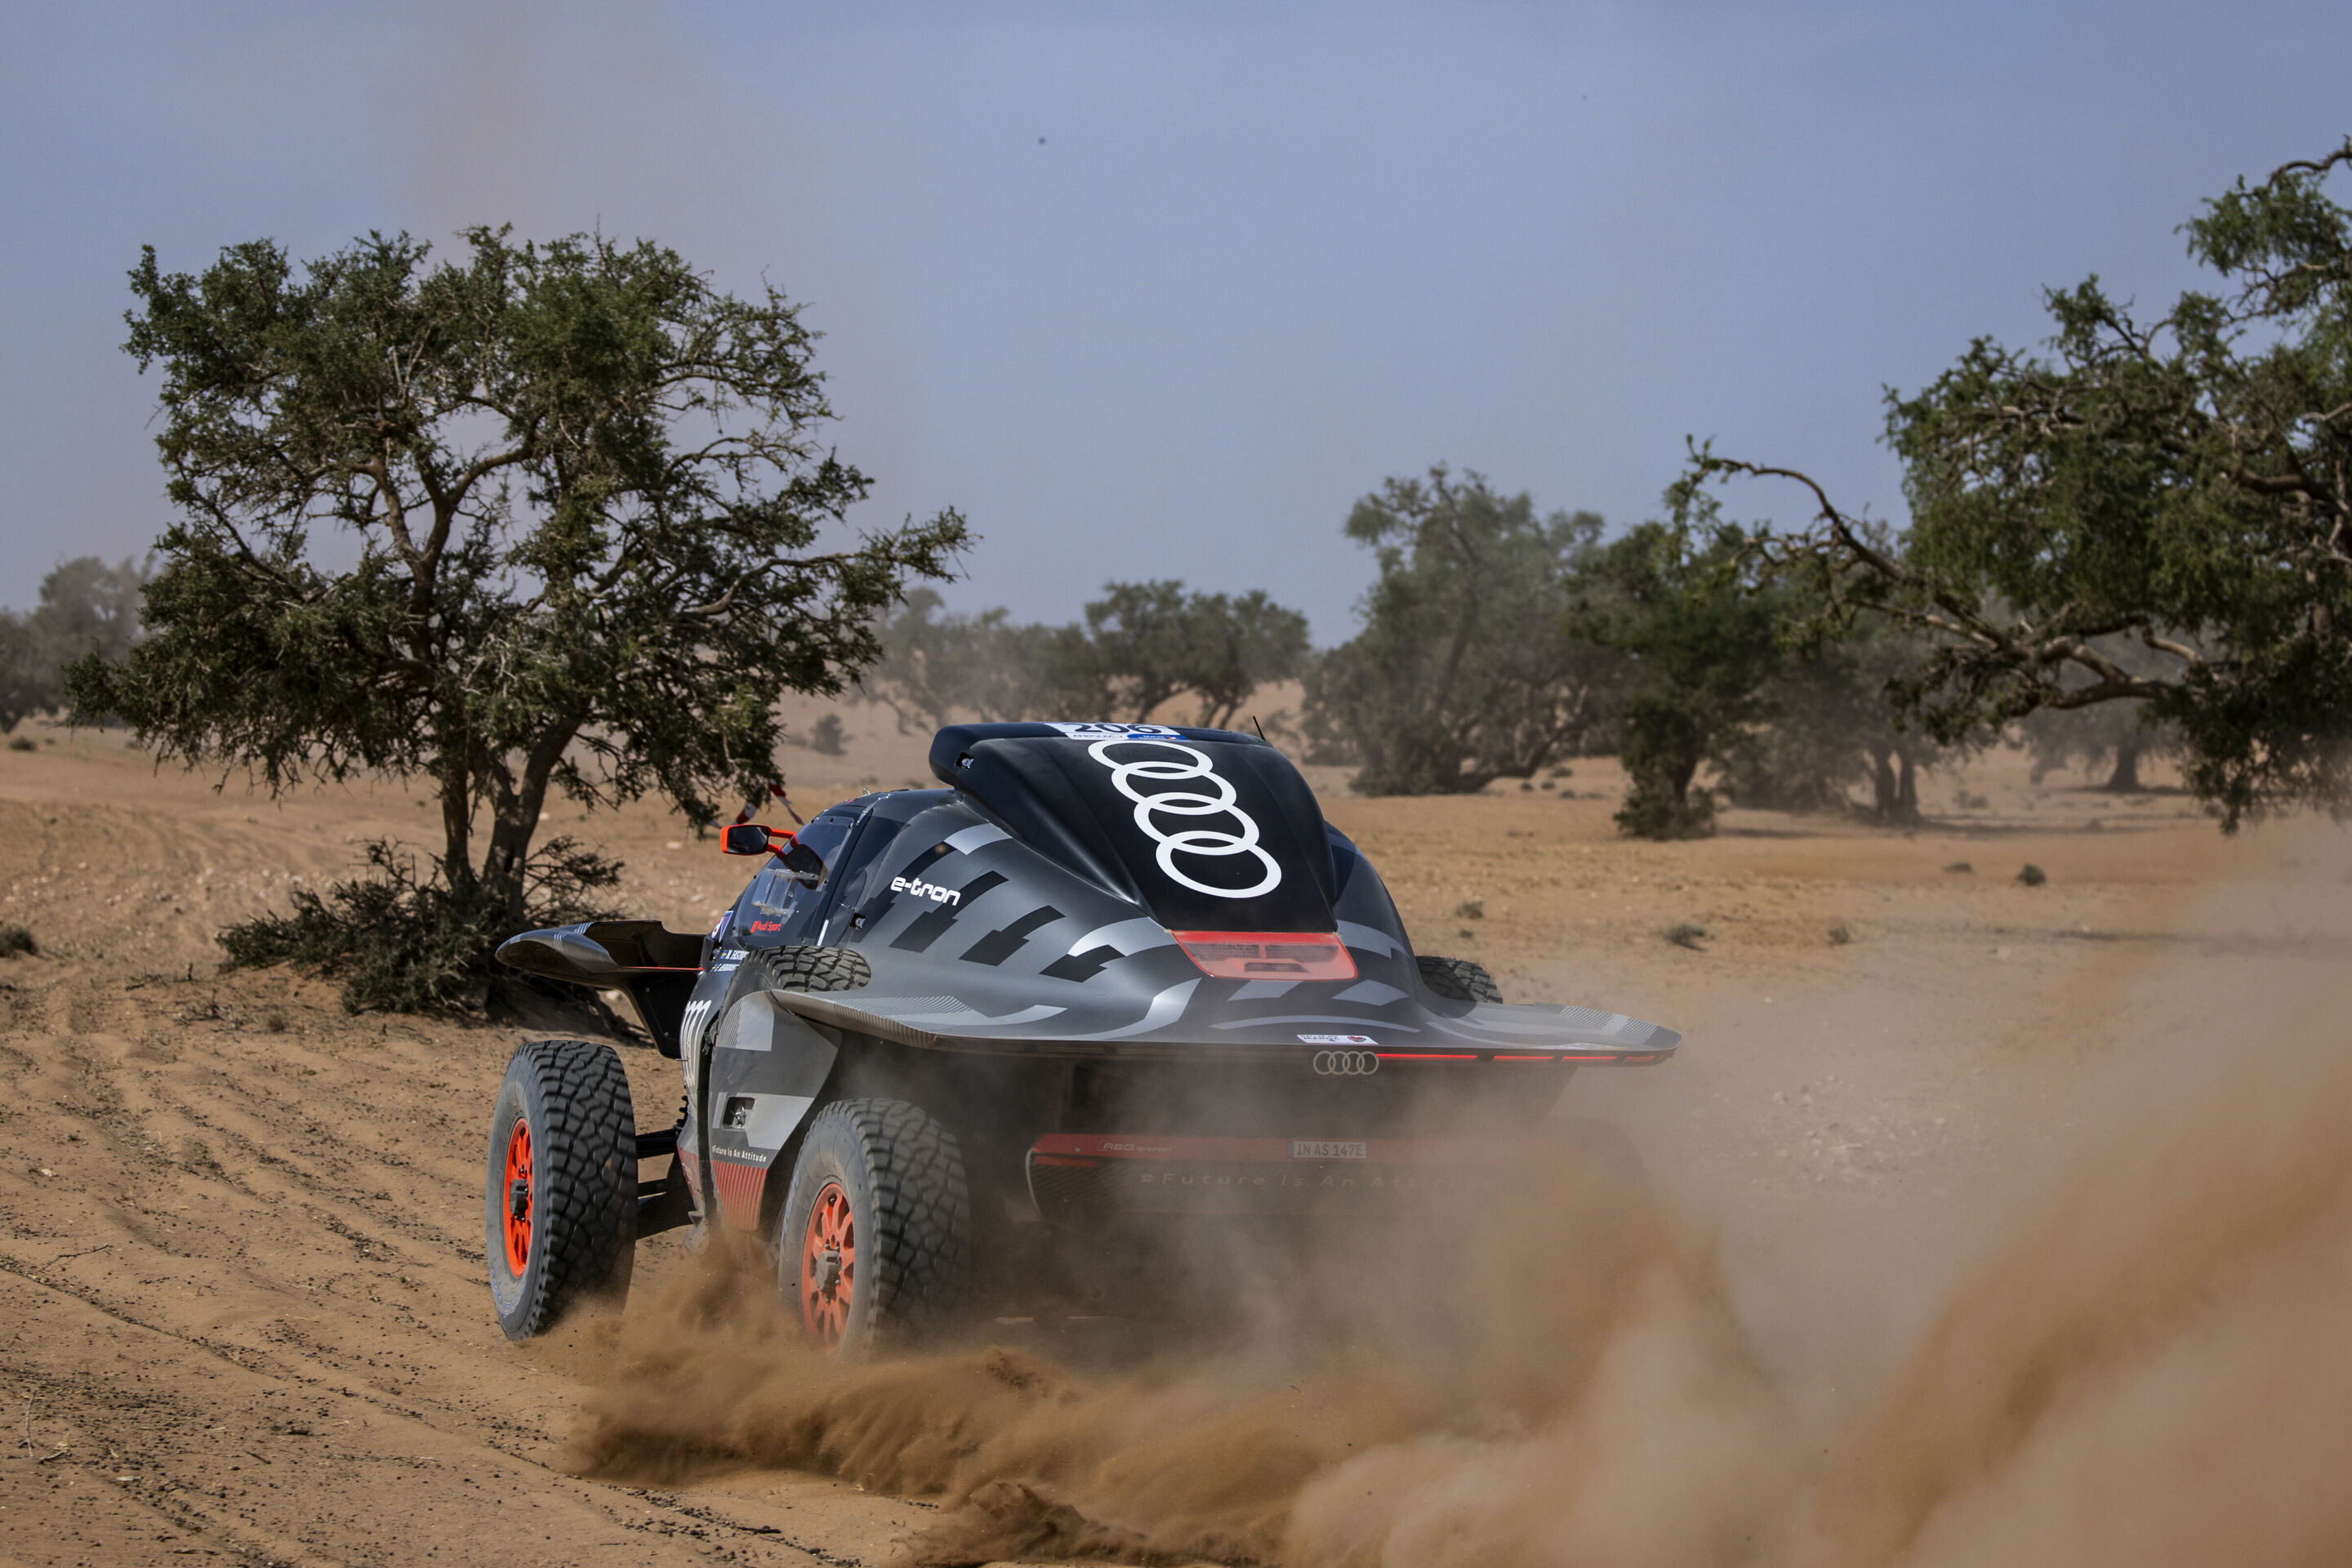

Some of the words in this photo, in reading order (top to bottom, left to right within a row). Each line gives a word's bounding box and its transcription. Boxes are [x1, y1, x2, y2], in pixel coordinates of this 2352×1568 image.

[1062, 724, 1162, 734] 206
[890, 876, 961, 906] e-tron
[757, 920, 768, 931] Audi
[768, 920, 782, 933] Sport
[1314, 1144, 1330, 1156] AS
[1332, 1144, 1364, 1156] 147E
[742, 1151, 767, 1162] Attitude
[1141, 1173, 1265, 1185] #Future
[1281, 1174, 1304, 1186] Is
[1320, 1175, 1354, 1187] An
